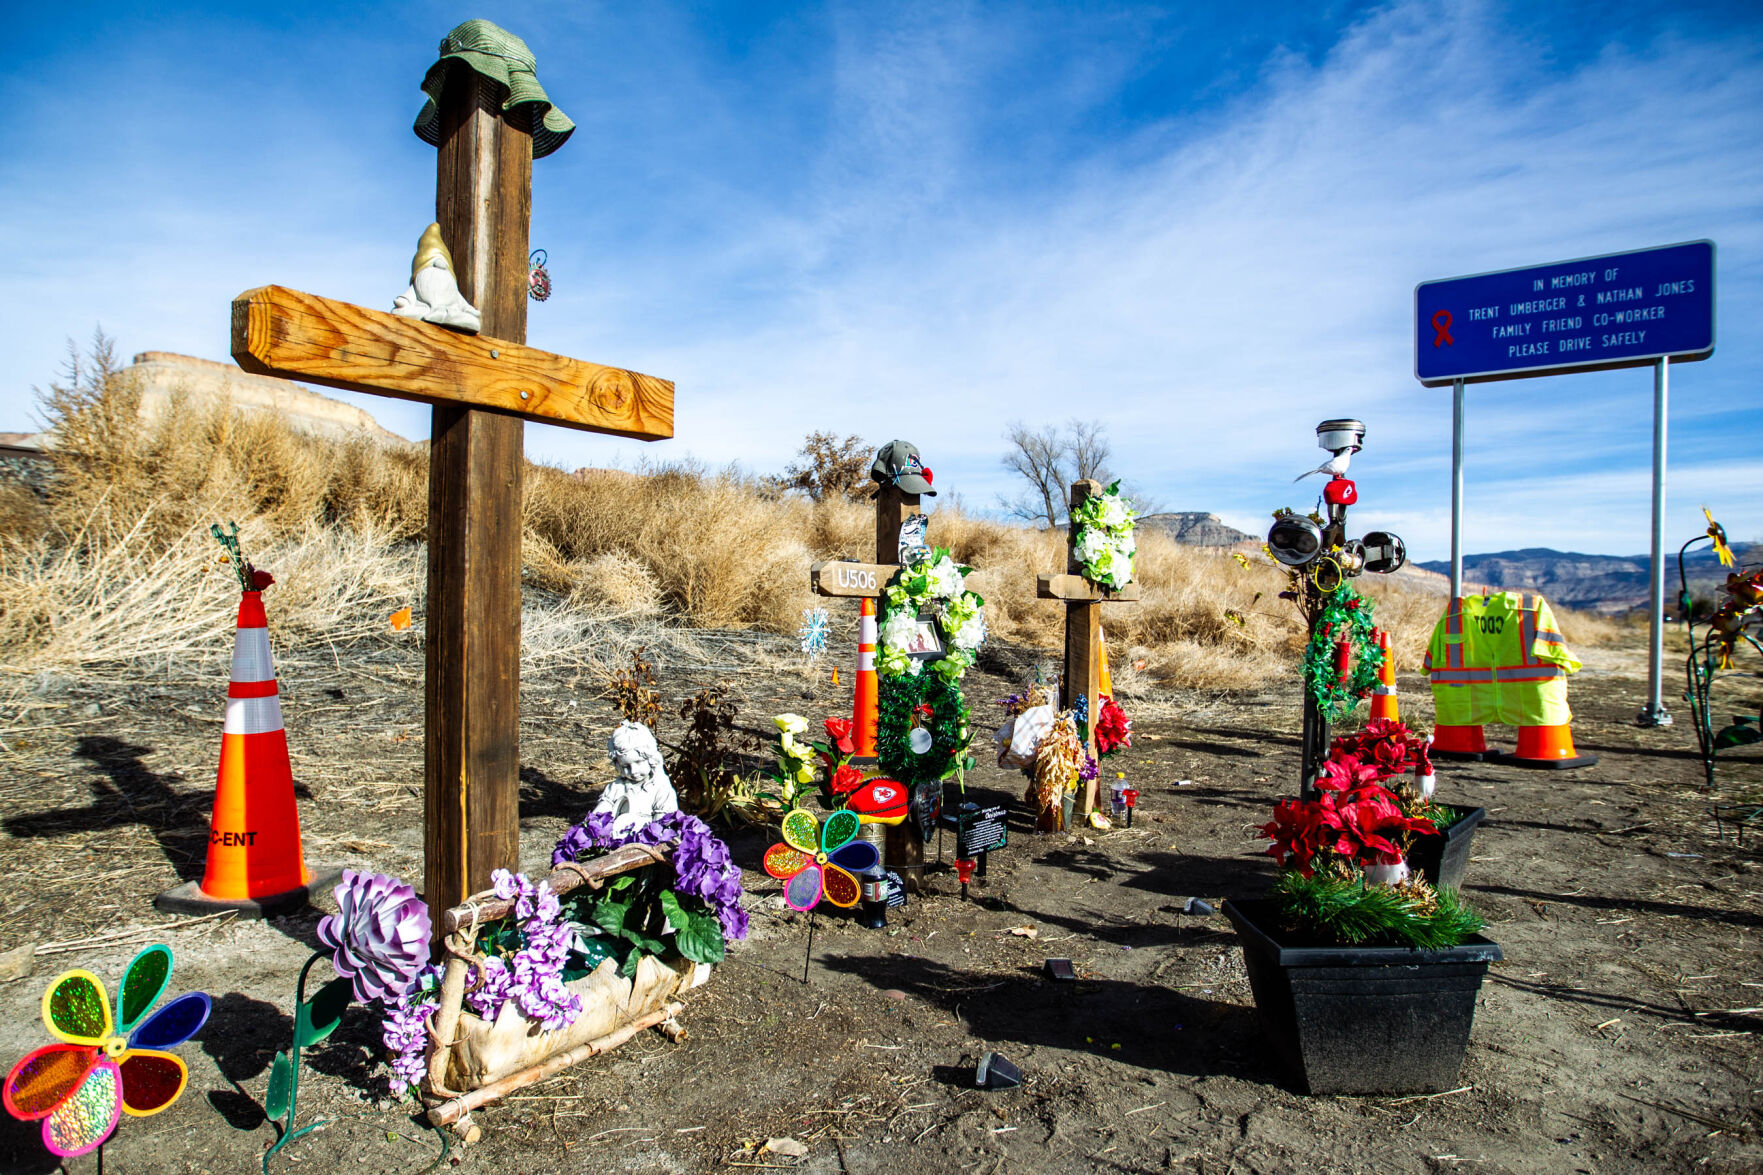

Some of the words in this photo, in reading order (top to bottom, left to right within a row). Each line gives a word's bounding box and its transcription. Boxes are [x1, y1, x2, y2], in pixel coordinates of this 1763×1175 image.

[1533, 279, 1544, 292] IN
[1551, 271, 1596, 289] MEMORY
[1605, 268, 1619, 282] OF
[1469, 306, 1500, 321] TRENT
[1510, 297, 1566, 316] UMBERGER
[1577, 294, 1586, 307] &
[1597, 287, 1643, 305] NATHAN
[1655, 279, 1695, 297] JONES
[1493, 323, 1532, 339] FAMILY
[1542, 316, 1582, 333] FRIEND
[1593, 306, 1665, 327] CO-WORKER
[1508, 341, 1550, 358] PLEASE
[1559, 336, 1592, 353] DRIVE
[1602, 330, 1646, 348] SAFELY
[838, 568, 877, 590] U506
